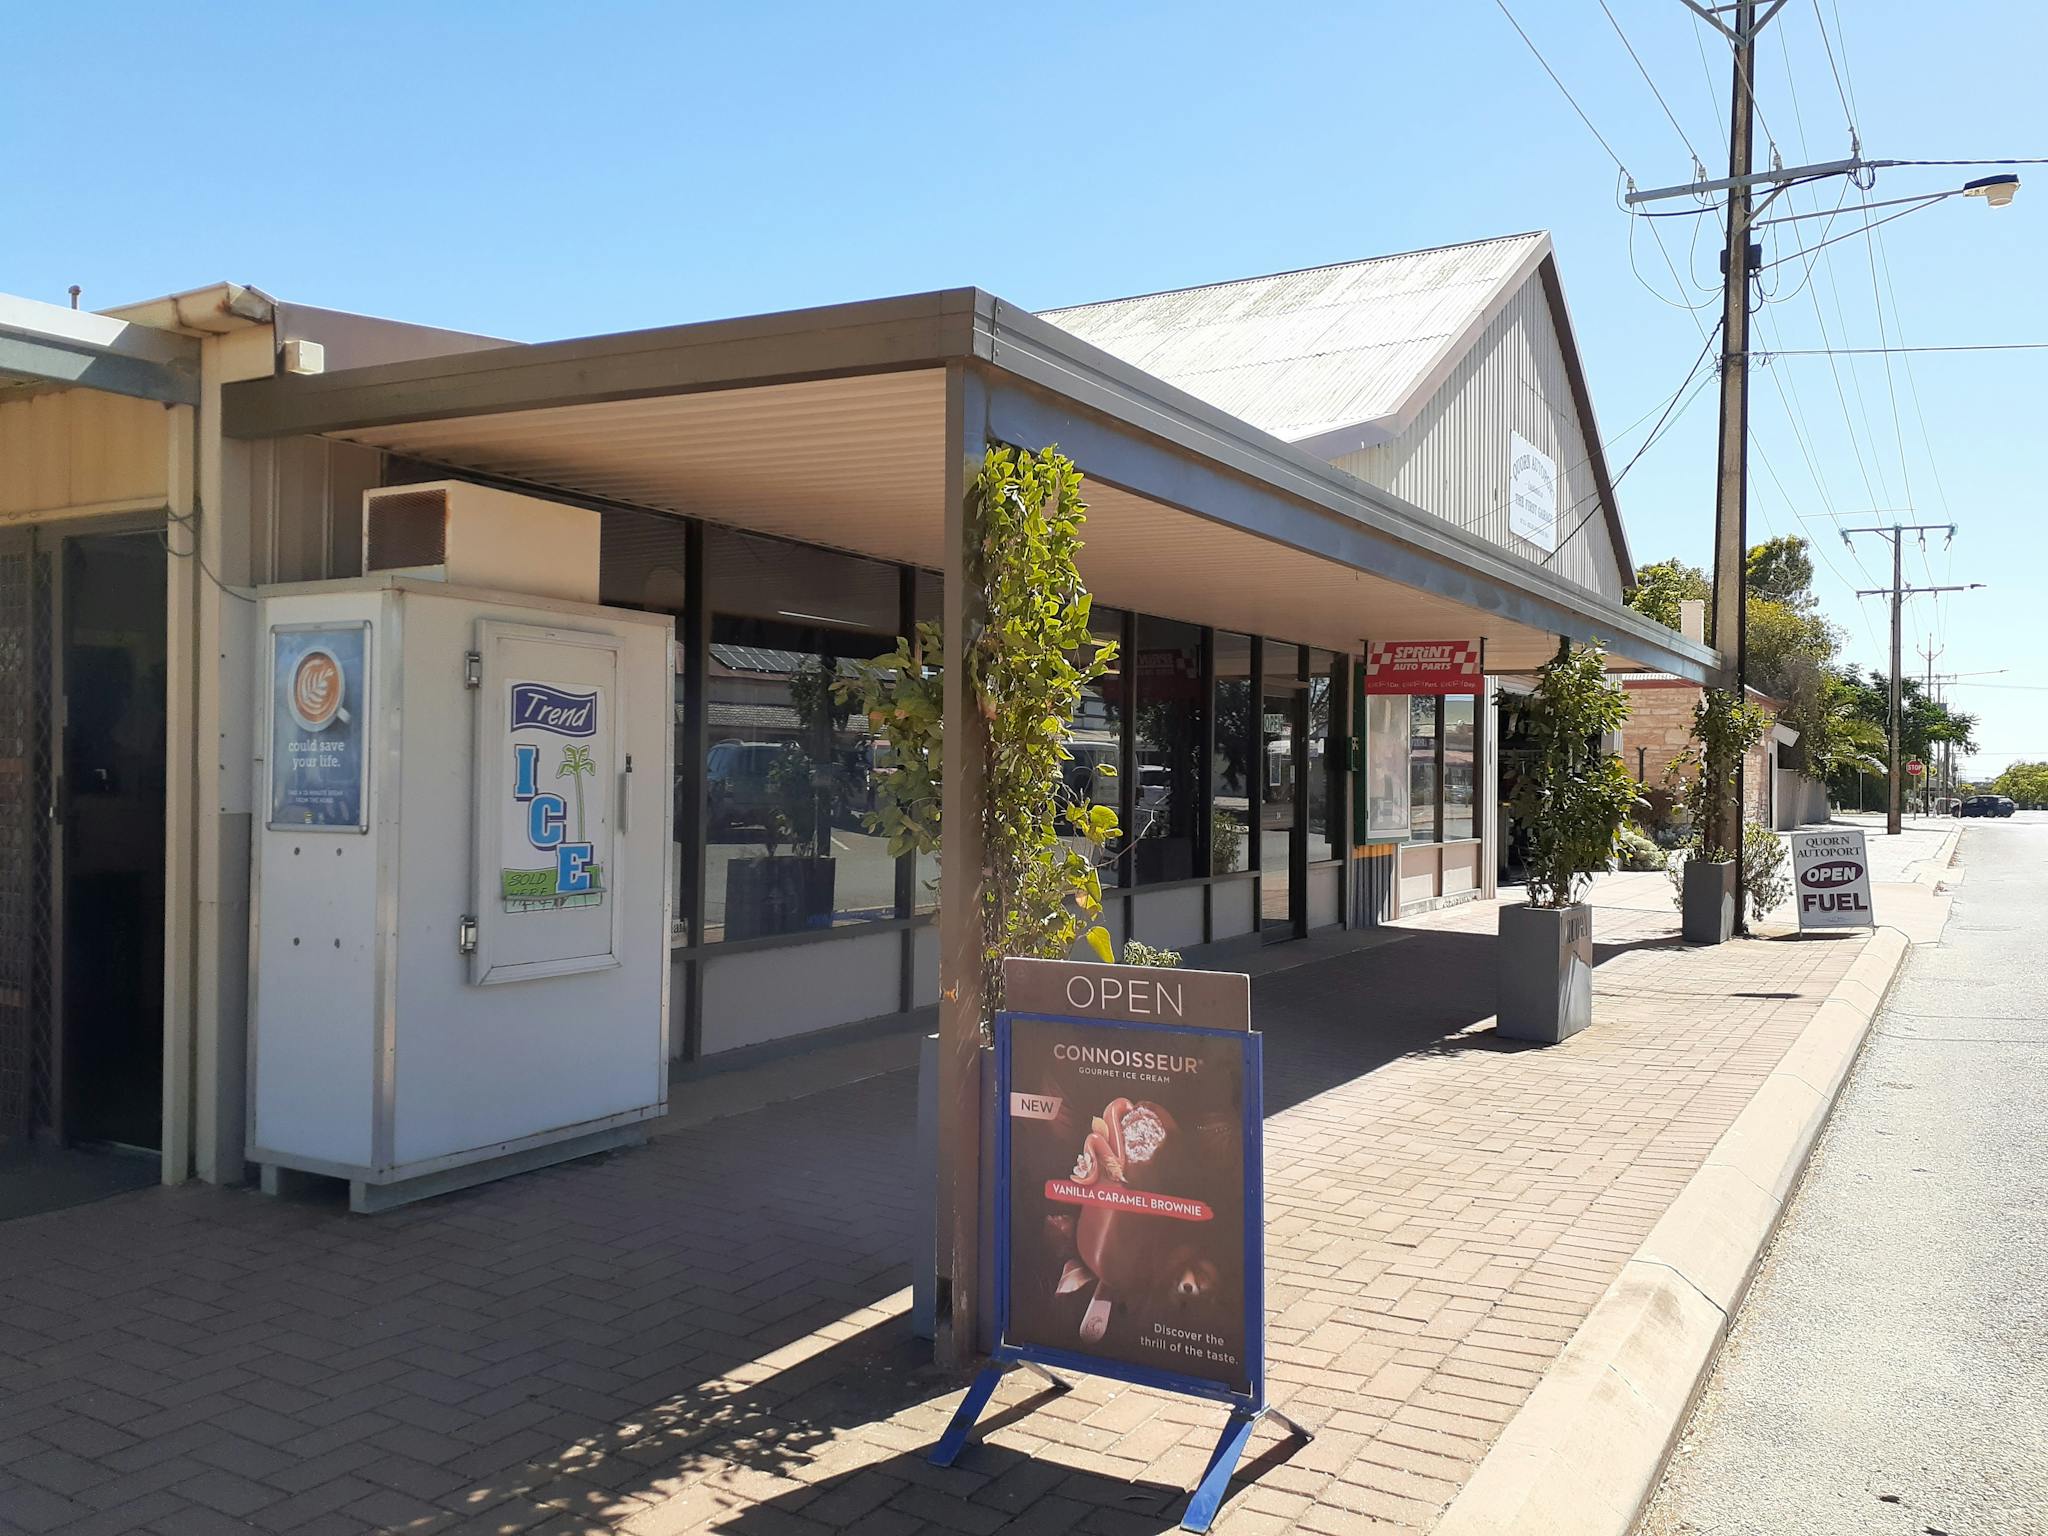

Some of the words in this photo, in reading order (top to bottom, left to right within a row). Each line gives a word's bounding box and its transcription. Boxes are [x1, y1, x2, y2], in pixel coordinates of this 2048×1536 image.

[1393, 663, 1418, 671] AUTO
[1421, 663, 1452, 671] PARTS
[524, 693, 591, 727] Trend
[288, 739, 317, 752] could
[319, 741, 345, 752] save
[292, 757, 317, 770] your
[320, 754, 341, 767] life.
[1806, 836, 1850, 848] QUORN
[1797, 846, 1861, 858] AUTOPORT
[508, 873, 547, 886] SOLD
[1806, 866, 1856, 882] OPEN
[1802, 893, 1868, 912] FUEL
[1066, 975, 1183, 1016] OPEN
[1053, 1043, 1199, 1074] CONNOISSEUR
[1078, 1066, 1120, 1078] GOURMET
[1122, 1071, 1136, 1080] ICE
[1140, 1073, 1170, 1083] CREAM
[1021, 1098, 1054, 1114] NEW
[1053, 1183, 1095, 1200] VANILLA
[1097, 1190, 1148, 1208] CARAMEL
[1150, 1198, 1202, 1216] BROWNIE
[1154, 1323, 1202, 1341] Discover
[1206, 1333, 1224, 1346] the
[1140, 1335, 1166, 1350] thrill
[1170, 1342, 1181, 1353] of
[1185, 1345, 1203, 1357] the
[1207, 1349, 1239, 1365] taste.
